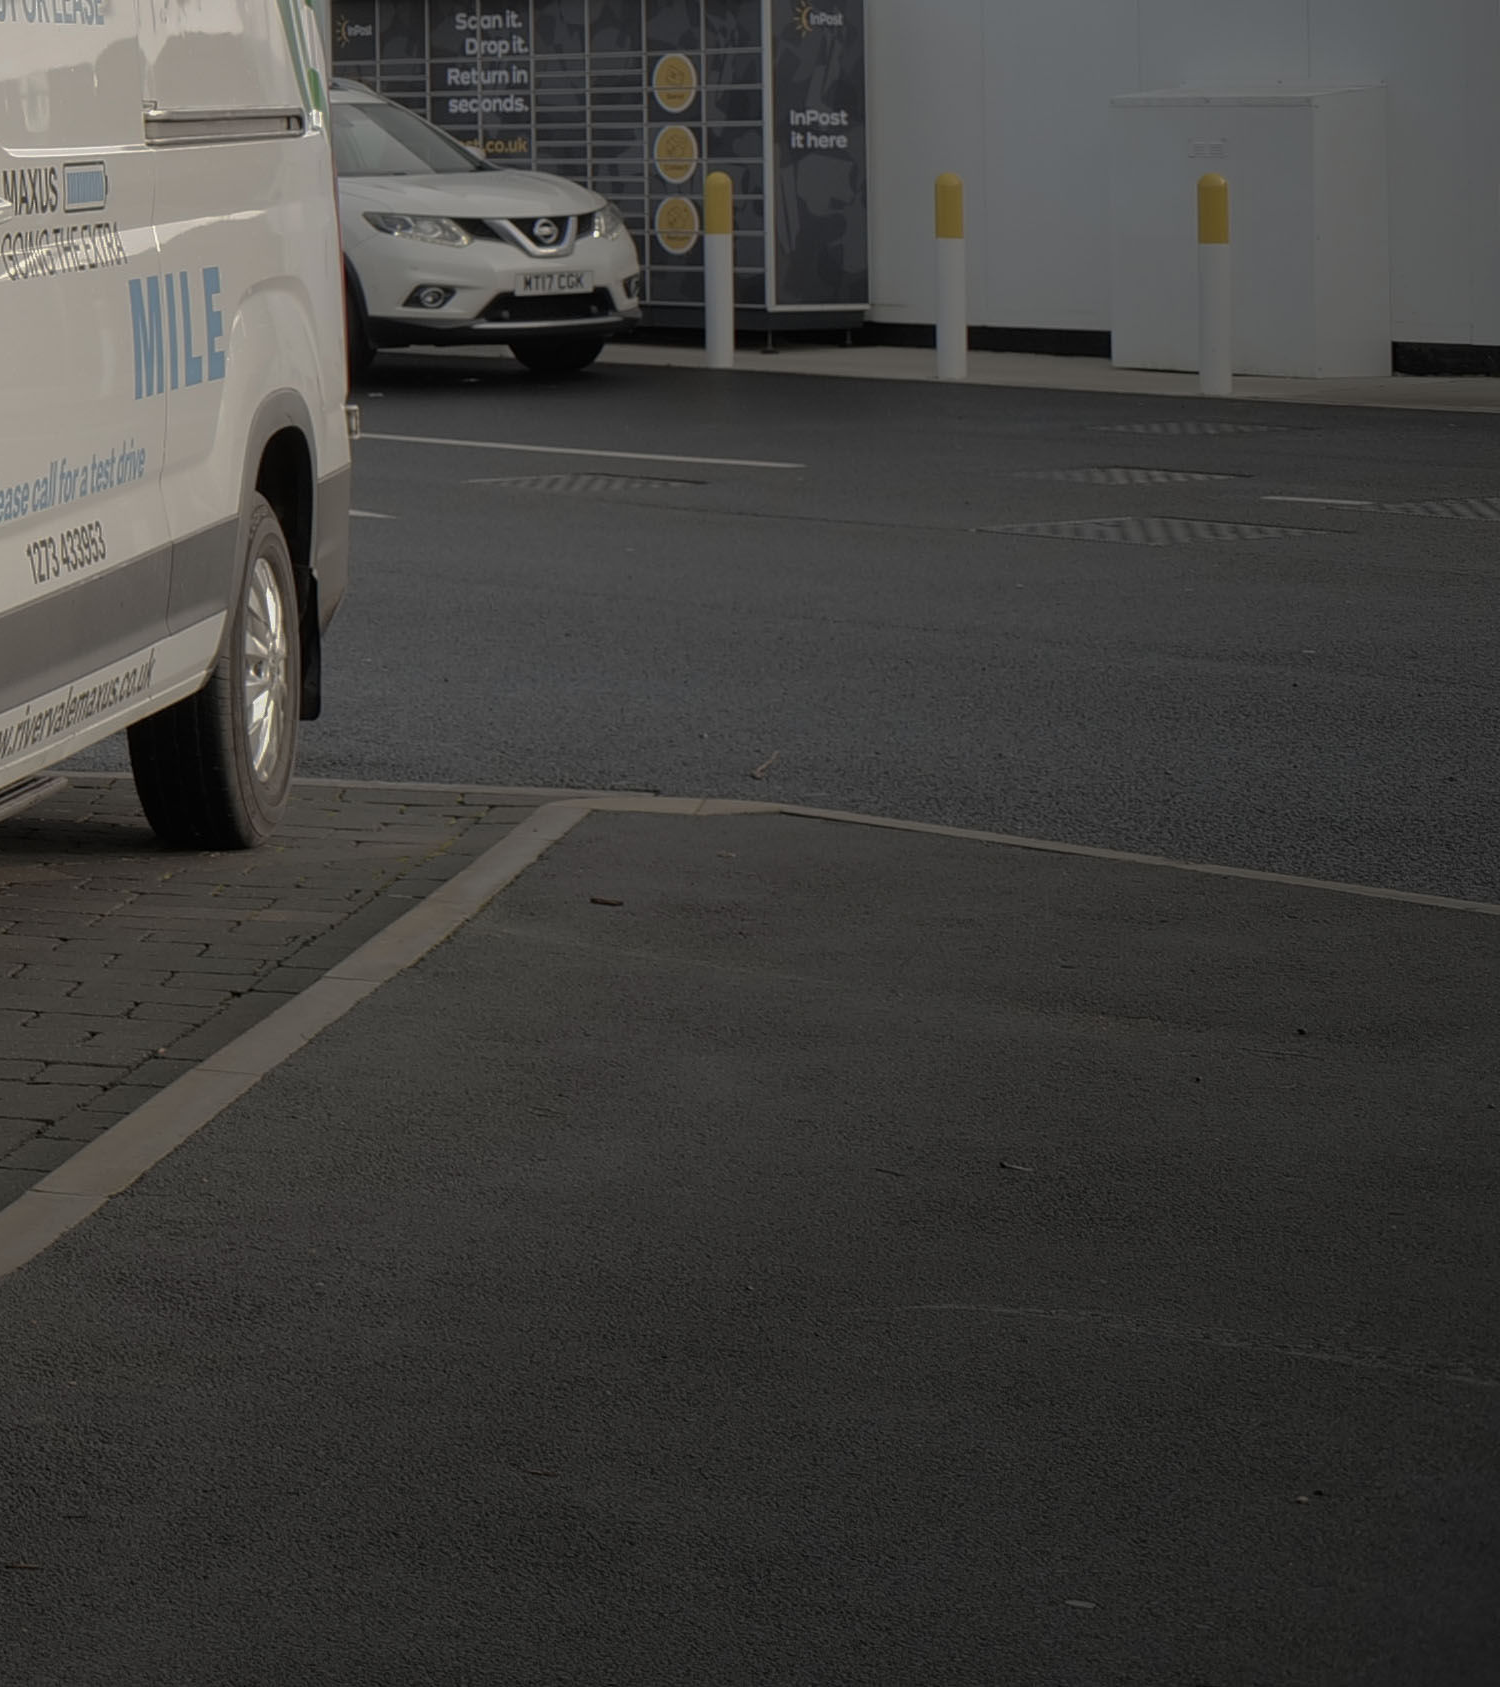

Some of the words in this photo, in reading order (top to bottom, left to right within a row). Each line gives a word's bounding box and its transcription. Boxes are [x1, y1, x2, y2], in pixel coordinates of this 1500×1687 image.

[455, 12, 502, 30] Scan
[505, 10, 522, 28] it.
[809, 12, 843, 26] InPost
[465, 38, 510, 57] Drop
[512, 35, 528, 53] it.
[447, 67, 510, 85] Return
[512, 65, 528, 84] in
[448, 94, 529, 113] seconds.
[790, 109, 849, 126] InPost
[790, 131, 804, 148] it
[806, 131, 848, 149] here
[2, 167, 58, 216] MAXUS
[1, 229, 55, 281] GOING
[53, 224, 85, 274] THE
[81, 222, 128, 270] EXTRA
[128, 266, 225, 400] MILE
[32, 459, 58, 512] call
[59, 457, 79, 505] for
[79, 464, 89, 498] a
[91, 448, 116, 494] test
[116, 437, 146, 485] drive
[26, 535, 60, 584] 1273
[60, 520, 107, 572] 433953
